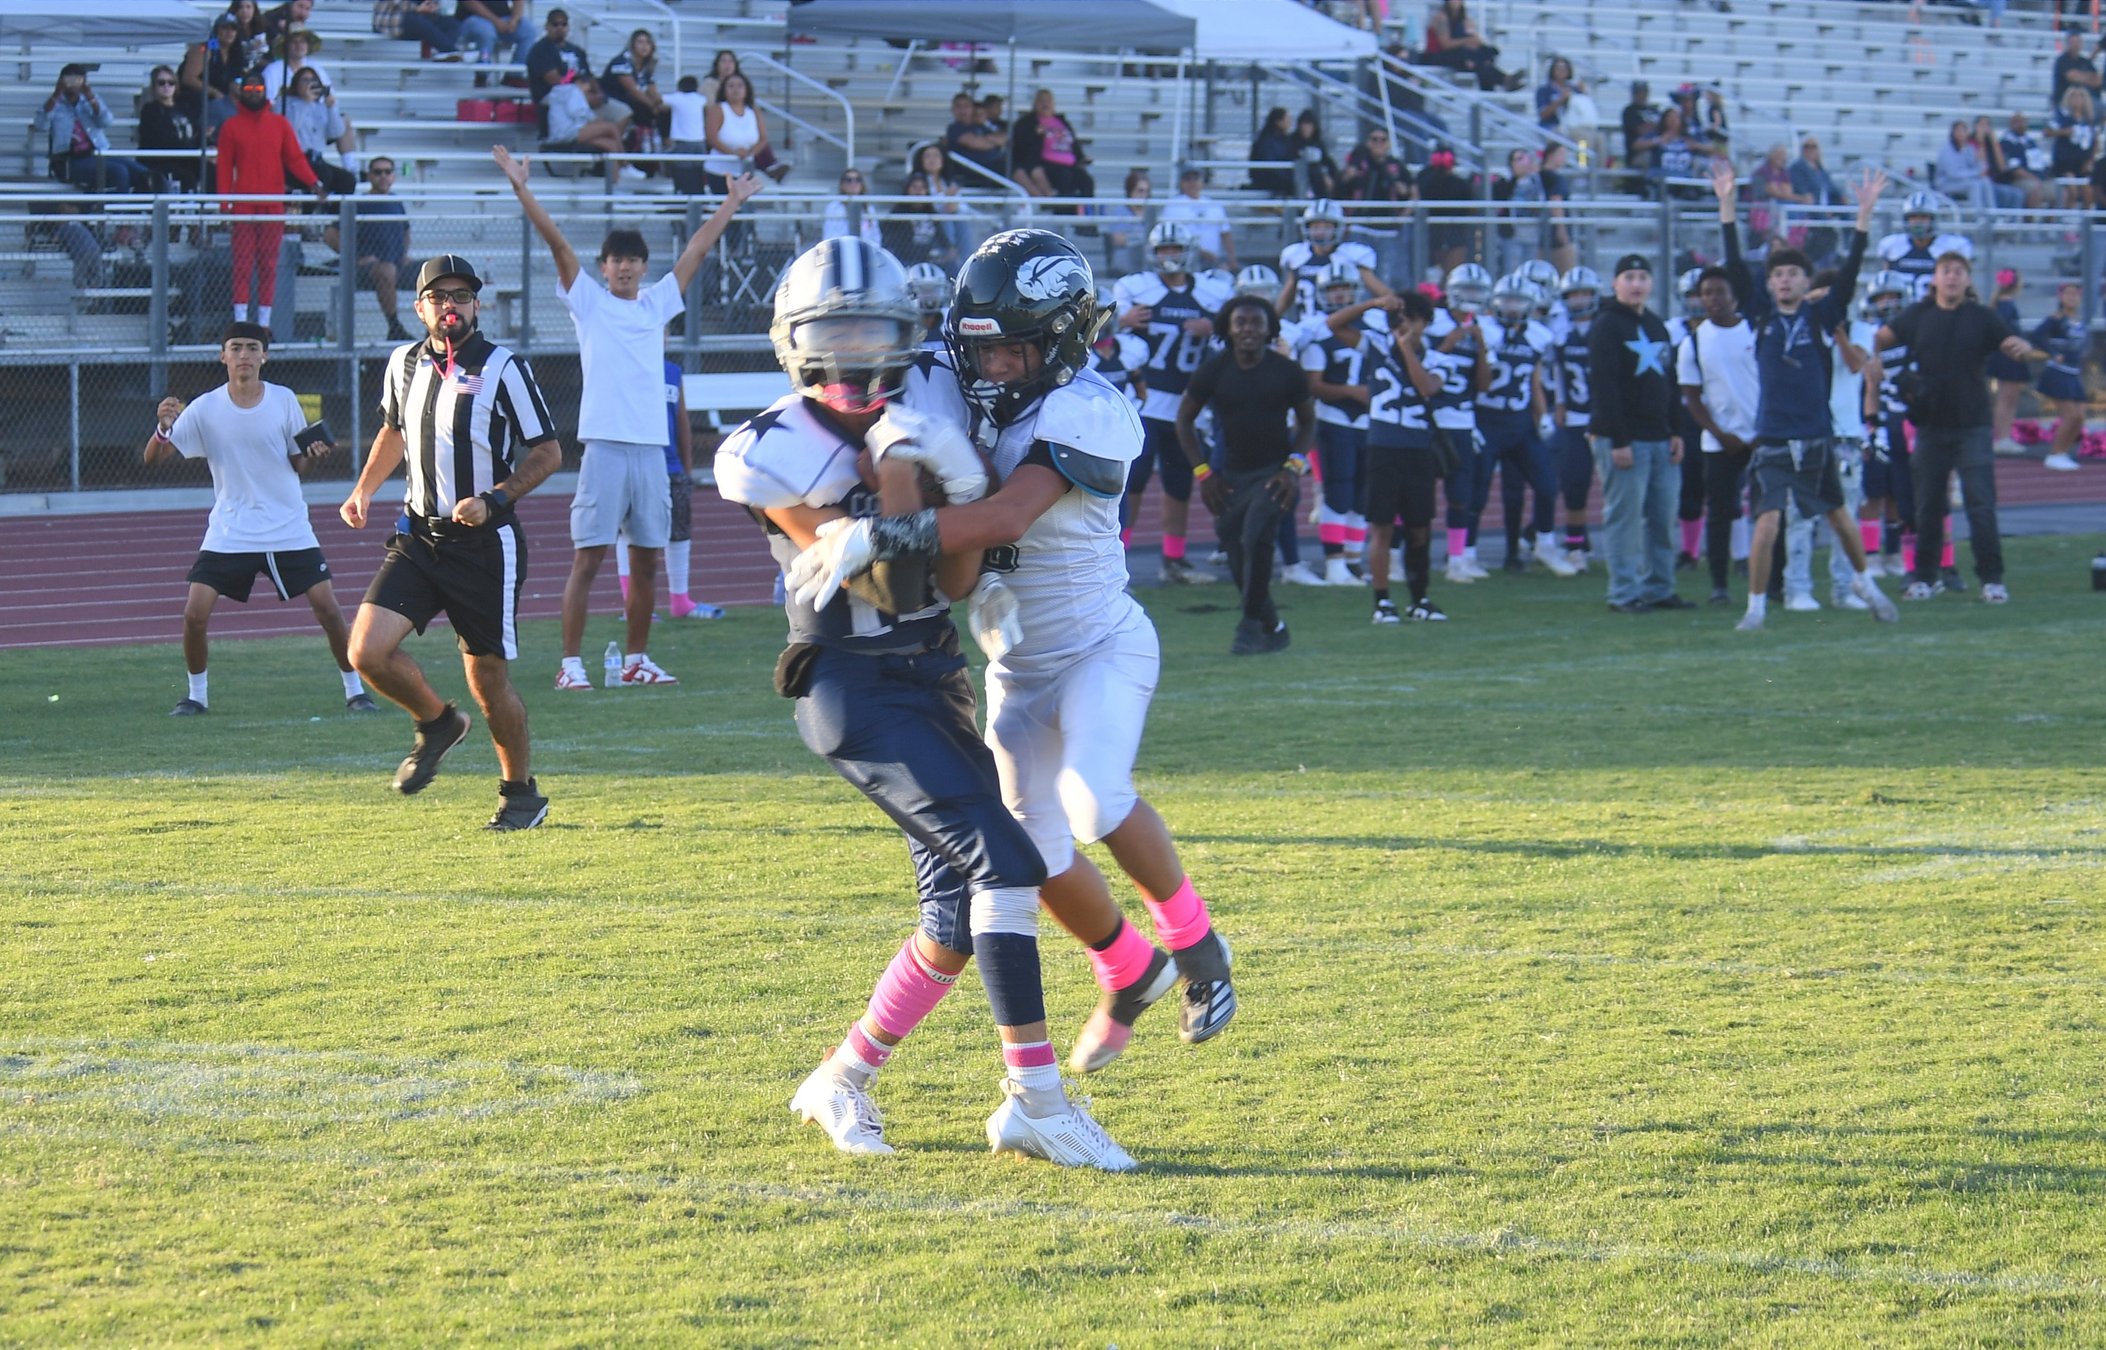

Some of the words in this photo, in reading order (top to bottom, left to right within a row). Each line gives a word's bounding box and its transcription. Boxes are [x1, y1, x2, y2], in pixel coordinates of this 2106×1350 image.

[962, 322, 992, 331] Riddell
[1148, 322, 1207, 373] 78
[1369, 366, 1429, 430] 22
[1476, 360, 1536, 411] 23
